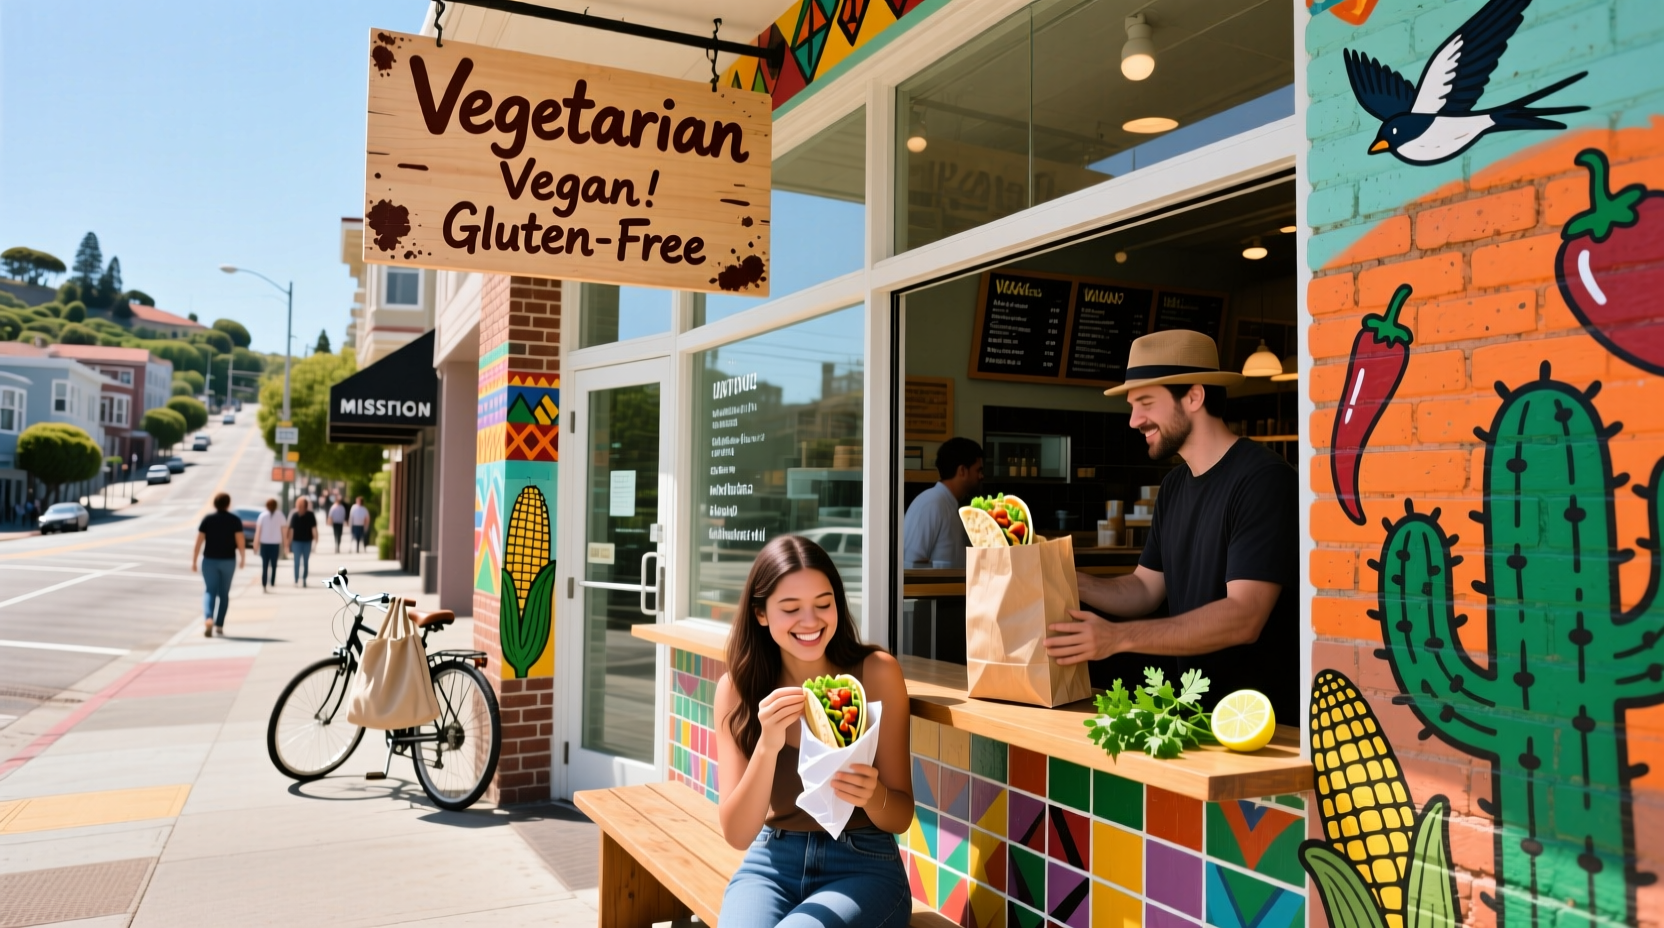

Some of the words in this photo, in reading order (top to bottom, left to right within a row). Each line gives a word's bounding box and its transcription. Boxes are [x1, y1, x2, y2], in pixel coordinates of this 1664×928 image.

[409, 54, 750, 164] Vegetarian
[500, 157, 660, 218] Vegan!
[442, 200, 707, 266] Gluten-Free
